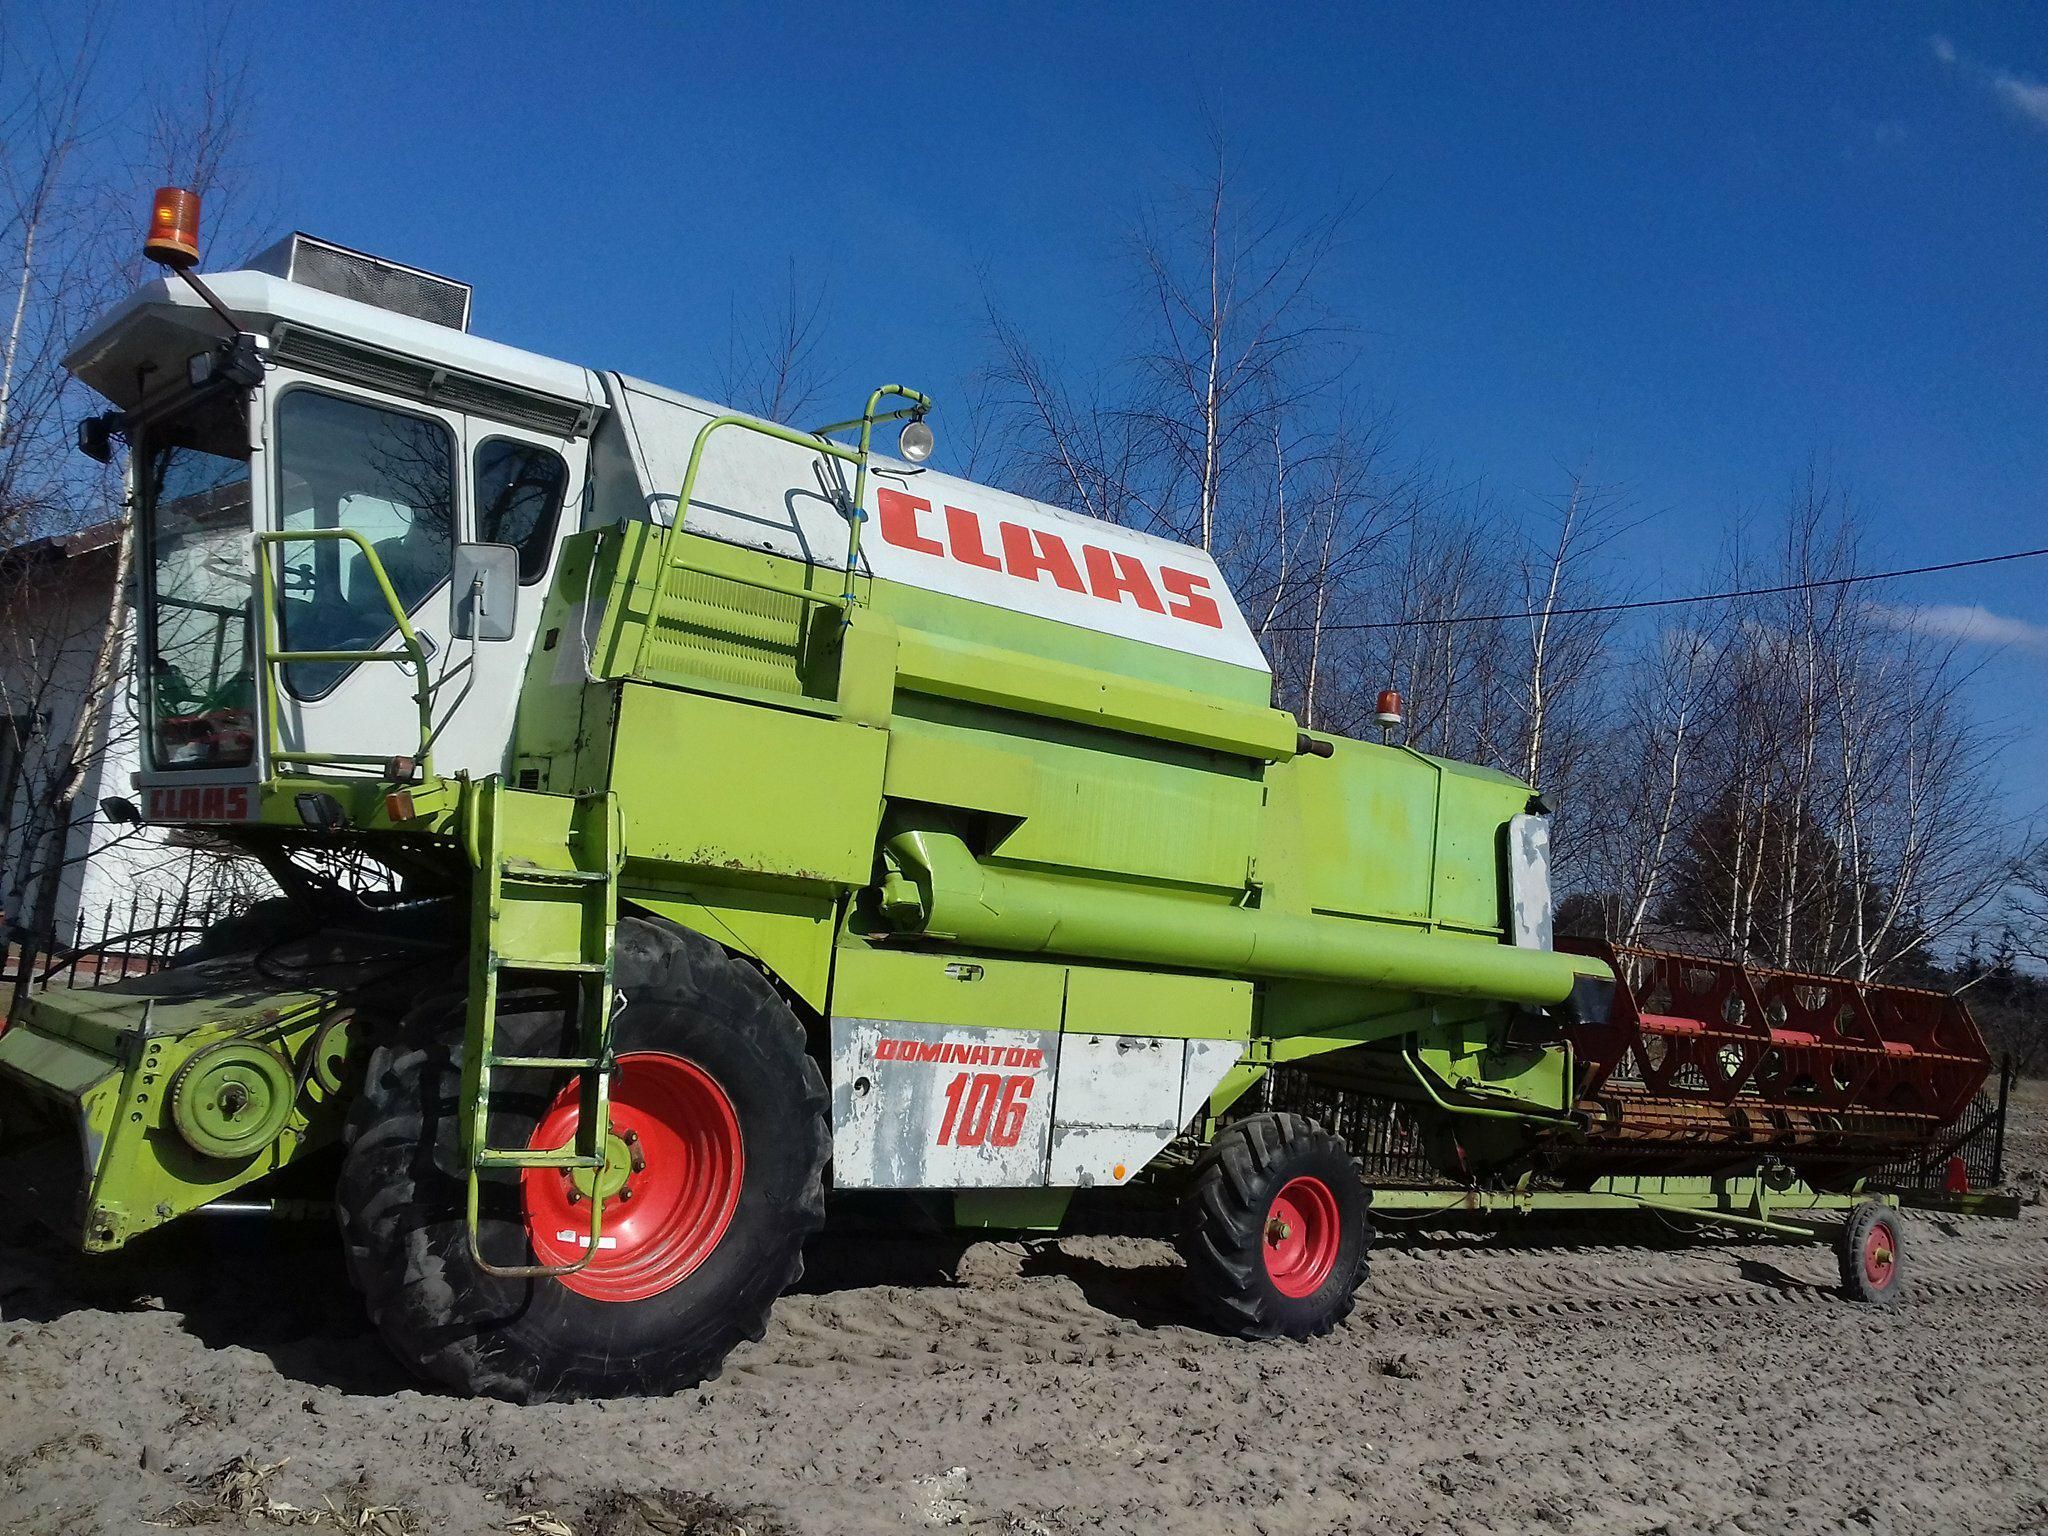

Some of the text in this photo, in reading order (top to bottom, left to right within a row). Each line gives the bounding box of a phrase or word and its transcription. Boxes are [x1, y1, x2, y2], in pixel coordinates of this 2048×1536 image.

[877, 487, 1222, 629] CLAAS
[151, 787, 248, 819] CLAAS
[875, 1039, 1044, 1068] DOMINATOR
[937, 1072, 1035, 1147] 106
